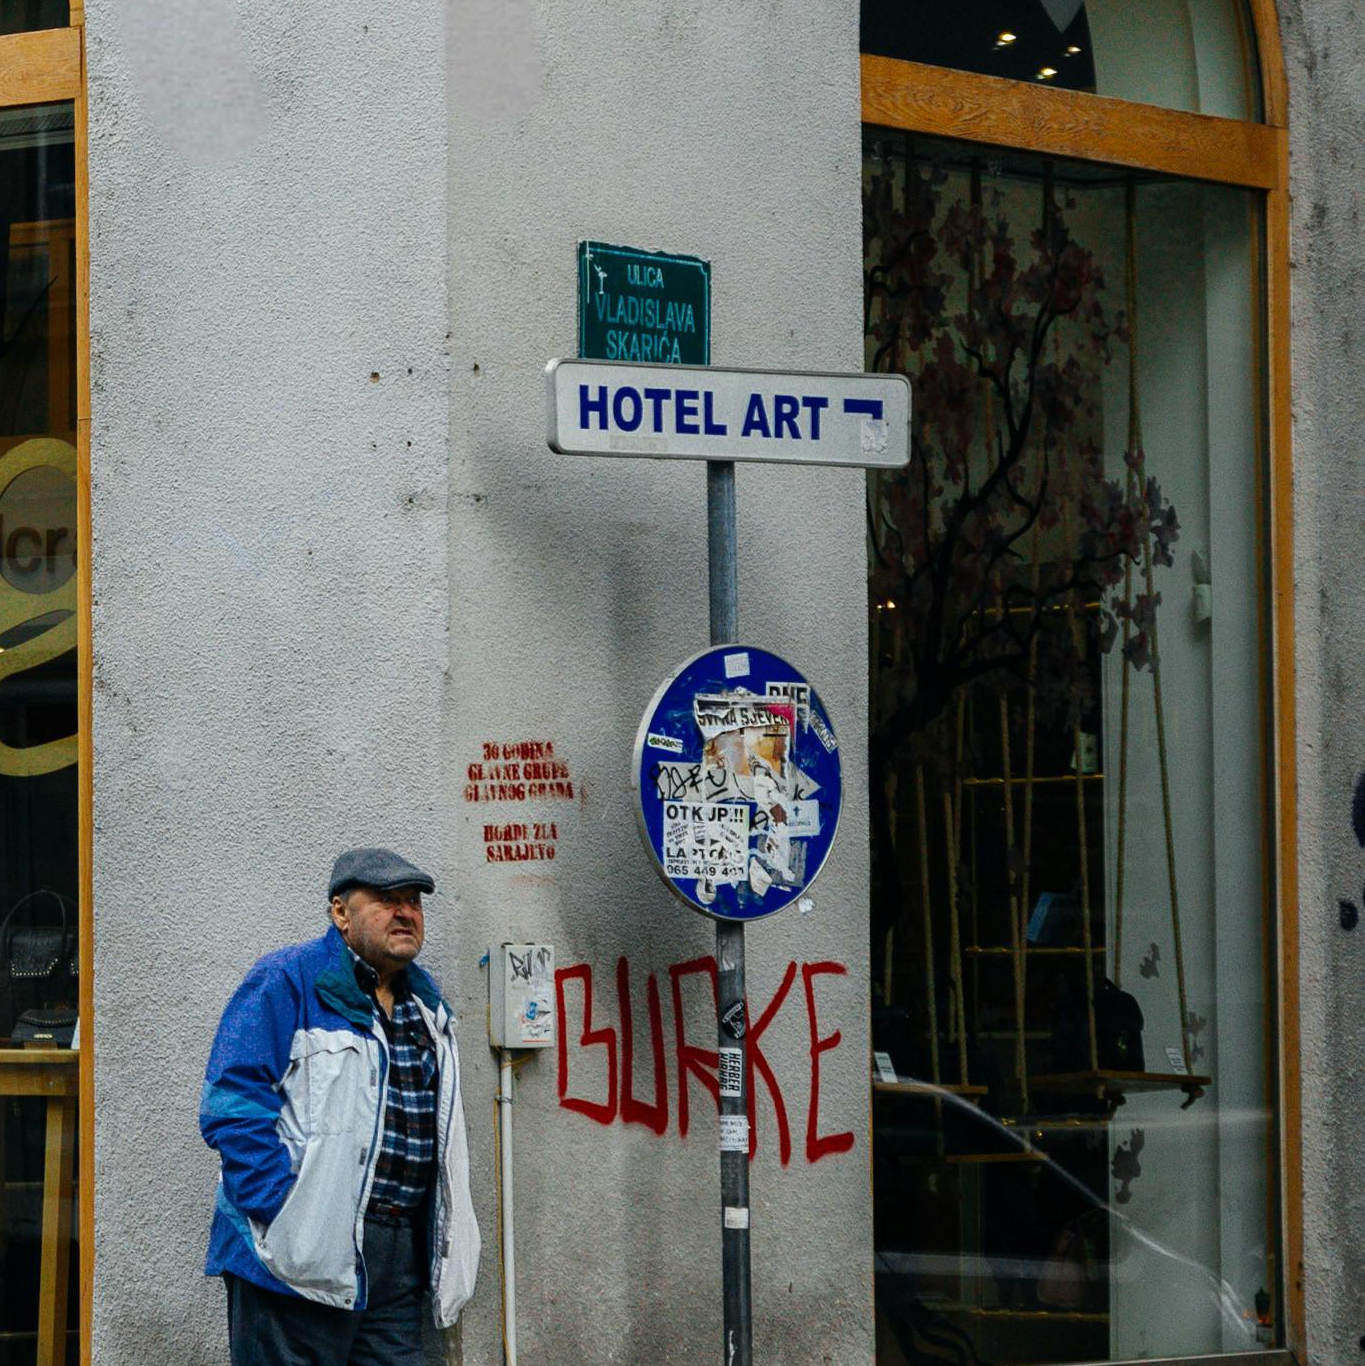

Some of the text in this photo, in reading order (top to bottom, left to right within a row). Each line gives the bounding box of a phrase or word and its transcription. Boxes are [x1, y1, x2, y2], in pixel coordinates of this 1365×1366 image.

[627, 264, 664, 288] ULICA
[595, 292, 695, 333] VLADISLAVA
[606, 329, 681, 364] SKARIĆA
[579, 384, 828, 440] HOTEL ART
[487, 843, 556, 863] SARAJEVO
